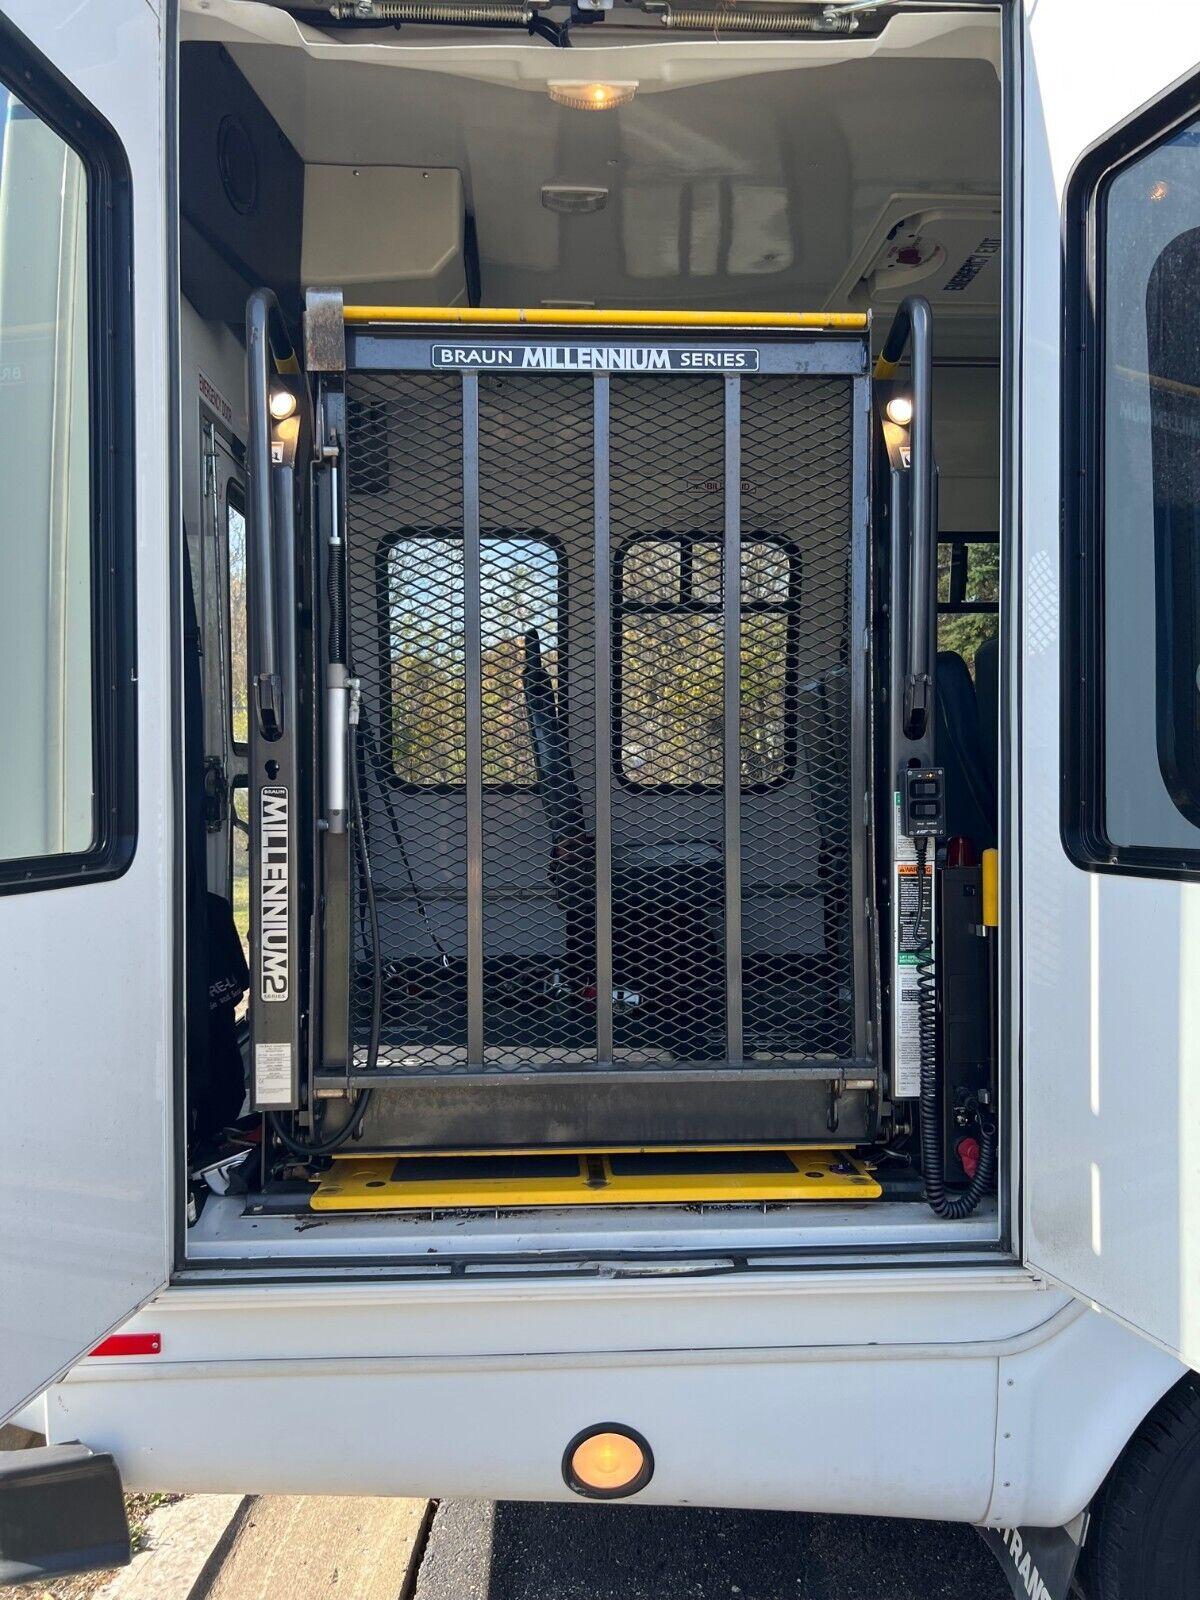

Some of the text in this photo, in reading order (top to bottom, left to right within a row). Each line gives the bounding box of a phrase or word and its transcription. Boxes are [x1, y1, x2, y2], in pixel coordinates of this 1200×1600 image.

[441, 346, 745, 370] BRAUN MILLENNIUM SERIES
